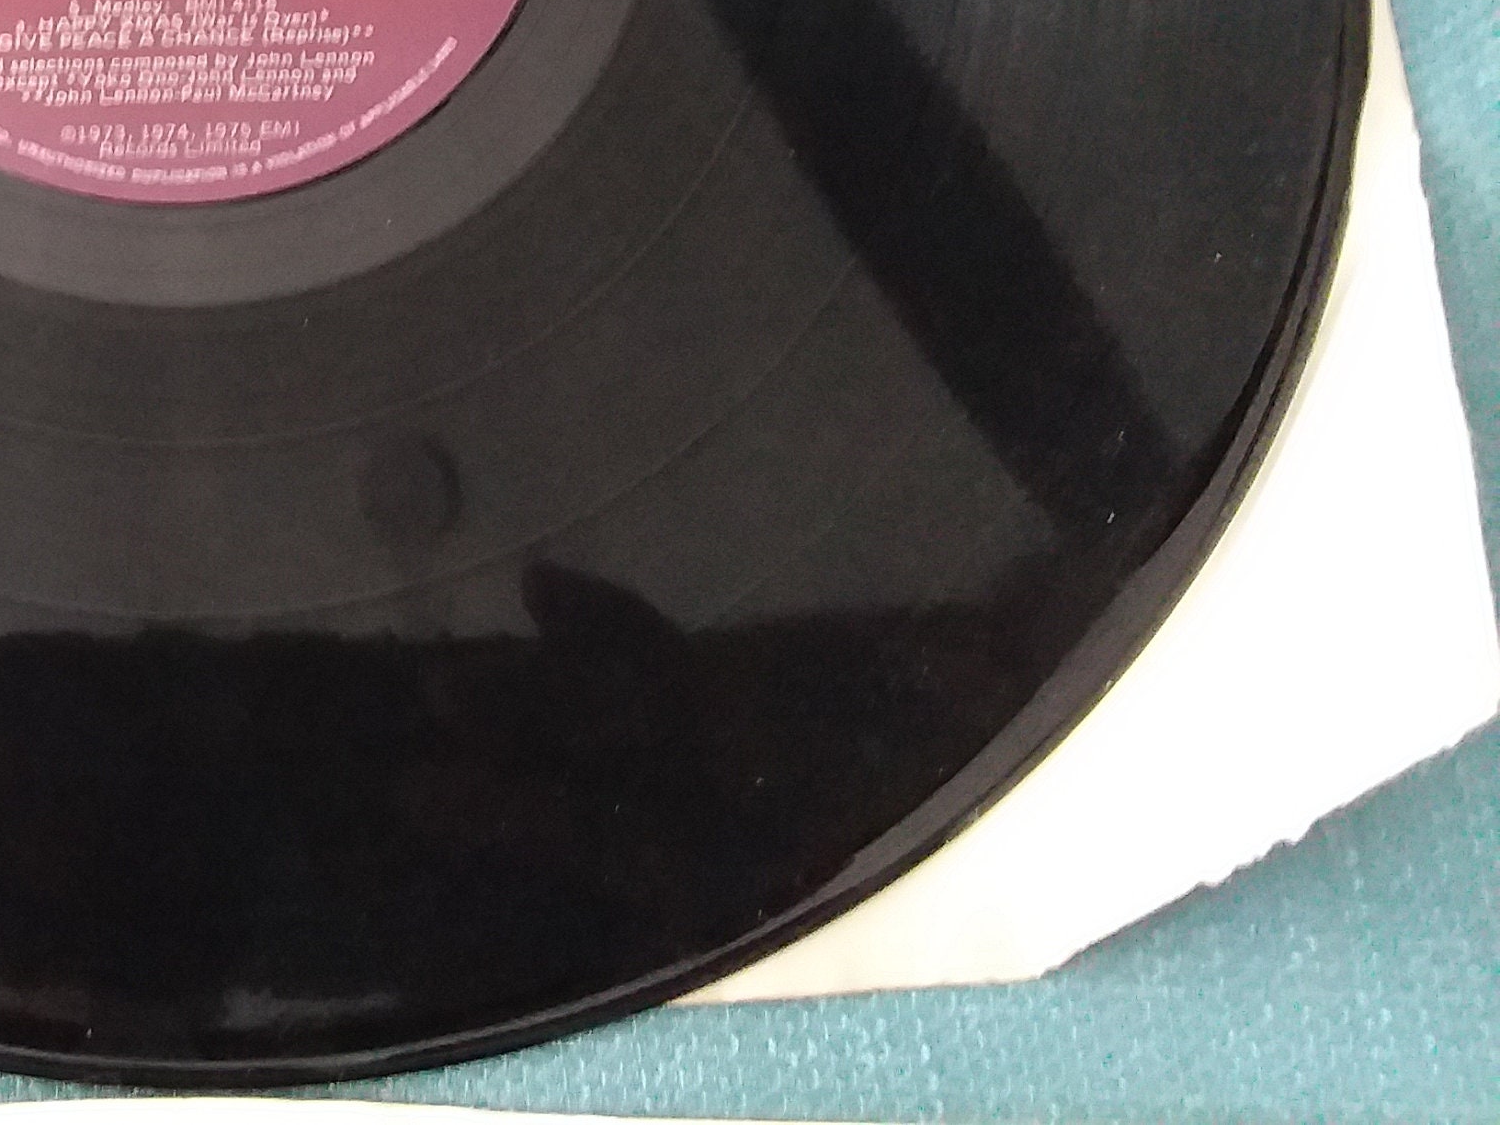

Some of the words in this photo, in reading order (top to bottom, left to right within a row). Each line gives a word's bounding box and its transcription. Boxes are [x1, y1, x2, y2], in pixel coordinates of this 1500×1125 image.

[38, 15, 114, 34] HAPPY
[119, 12, 184, 32] XMAS
[59, 30, 132, 51] PEACE
[138, 29, 154, 49] A
[160, 27, 255, 48] CHANCE
[10, 56, 104, 75] selections
[111, 53, 208, 74] composed
[214, 52, 239, 72] by
[247, 51, 293, 70] John
[300, 50, 376, 69] Lennon
[241, 67, 315, 86] Lennon
[322, 65, 358, 85] and
[227, 83, 335, 104] McCartney
[259, 120, 300, 140] EMI
